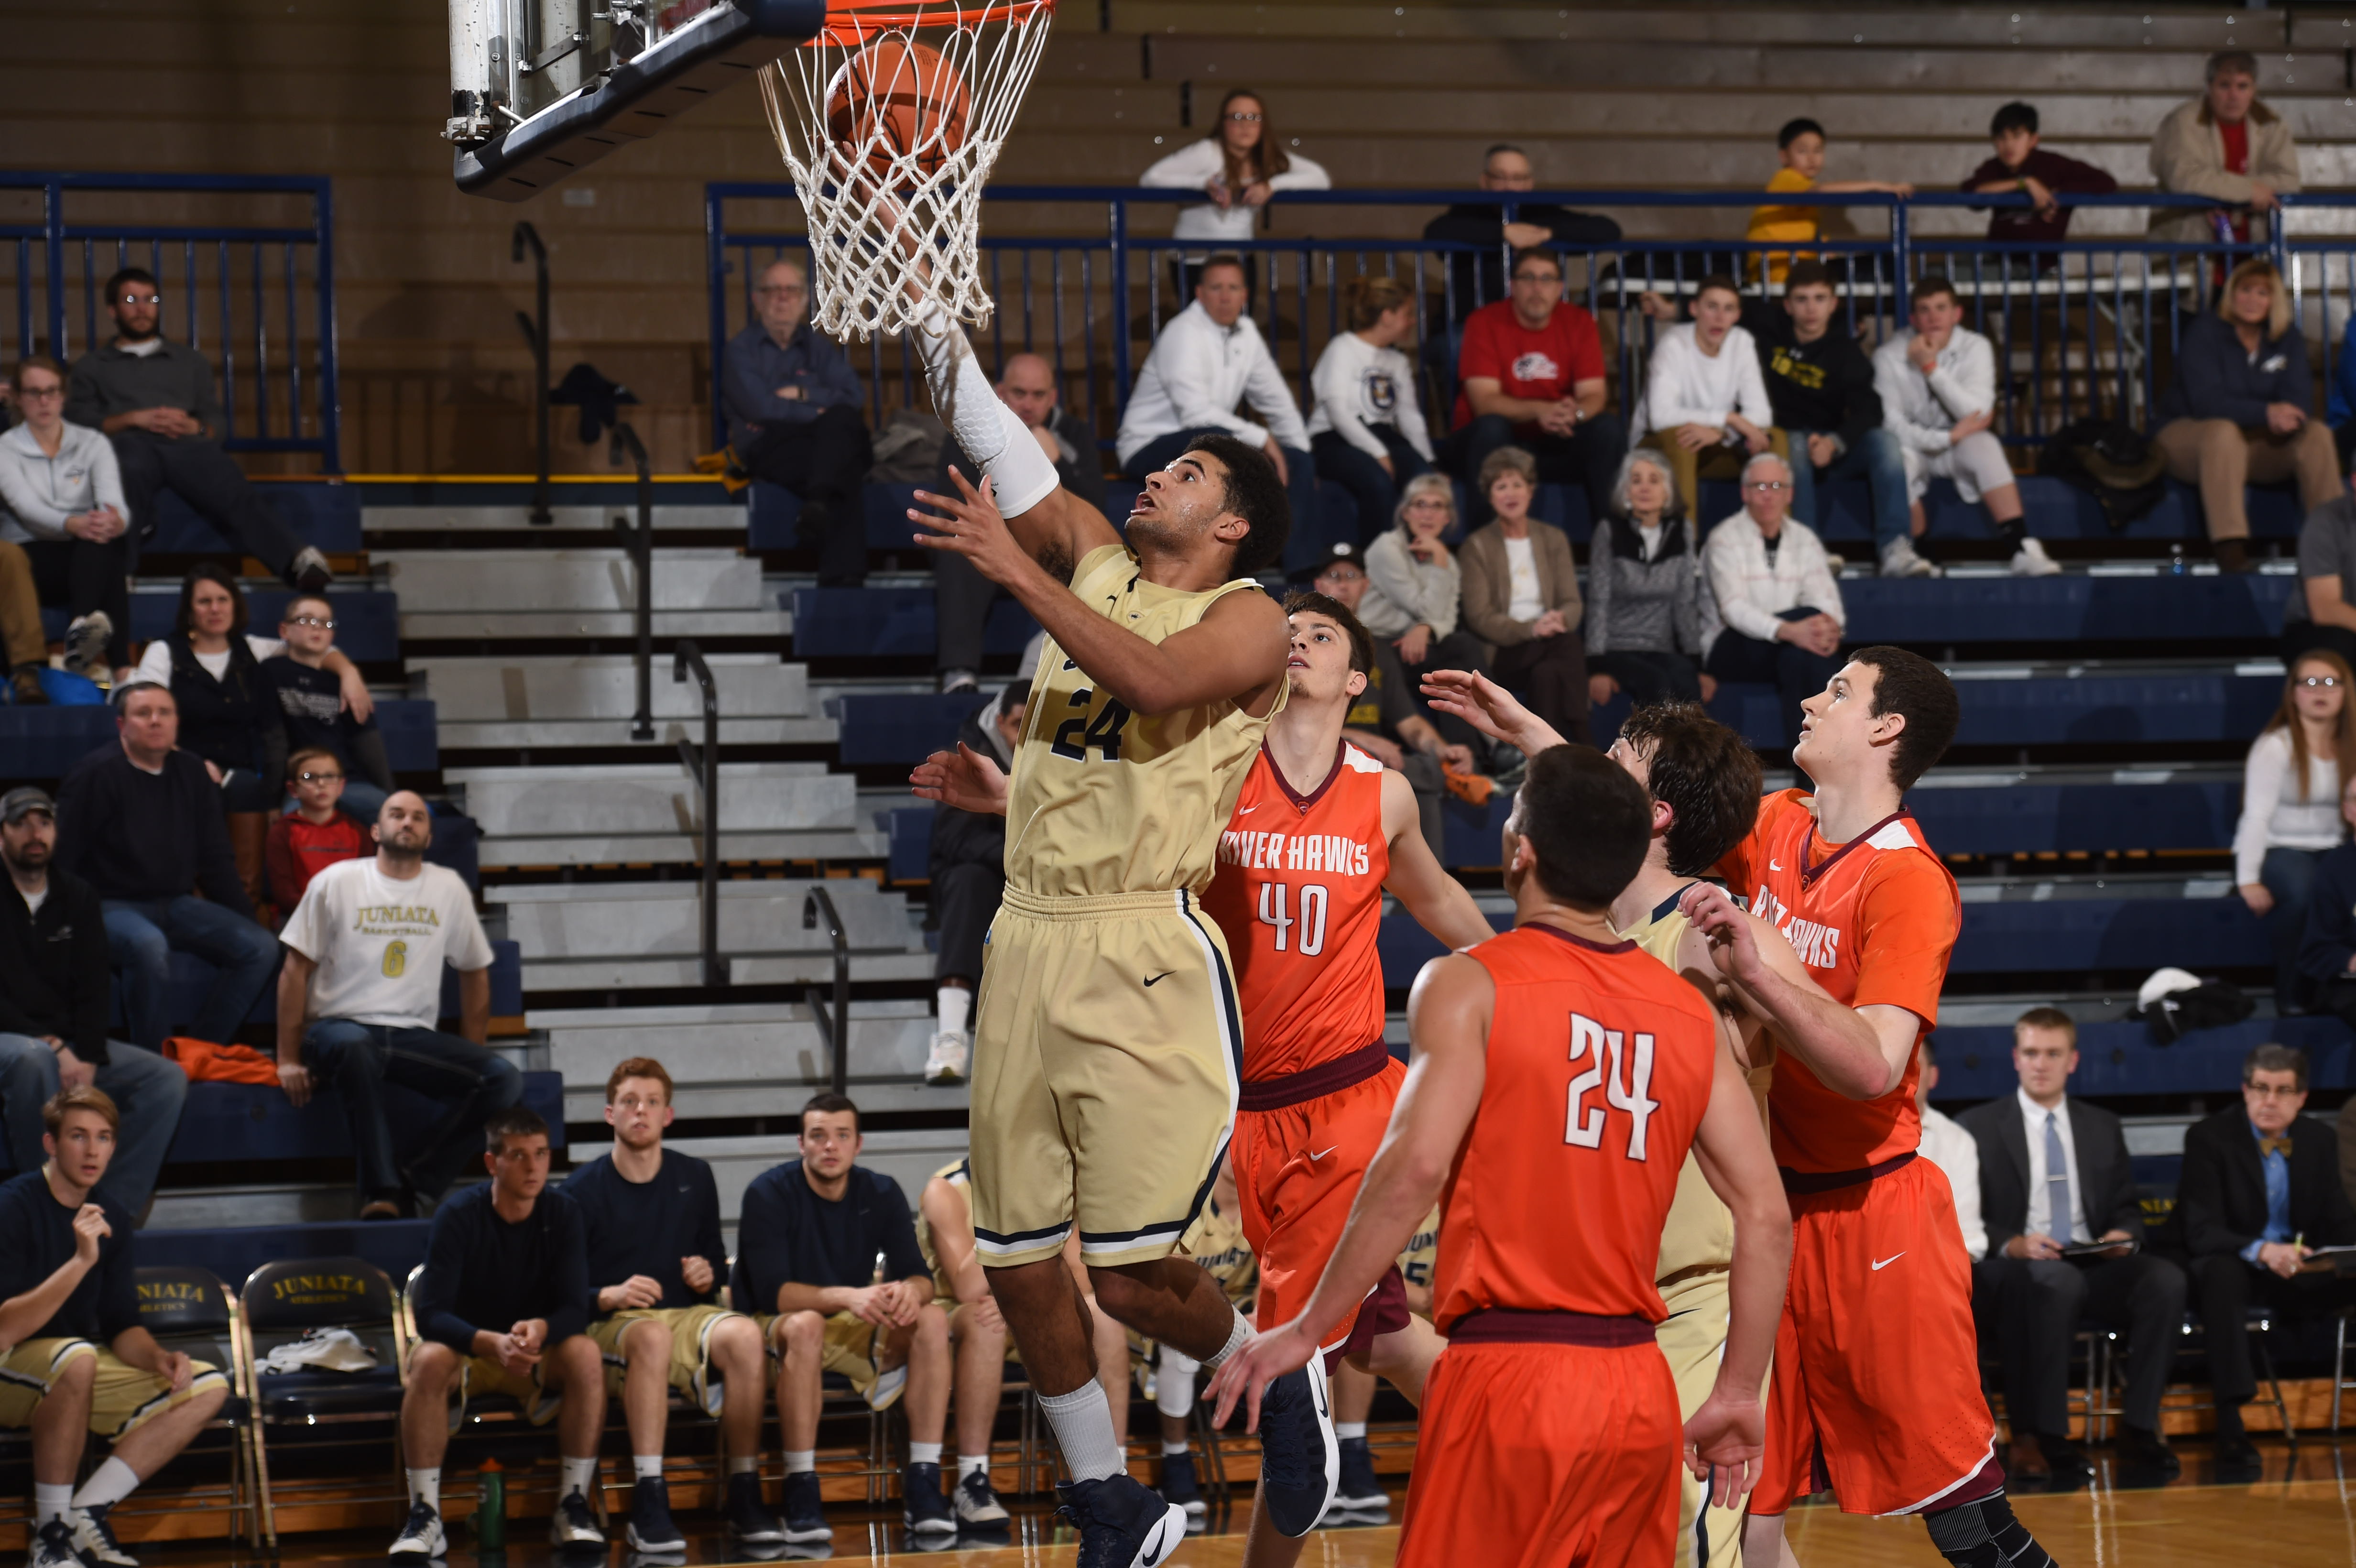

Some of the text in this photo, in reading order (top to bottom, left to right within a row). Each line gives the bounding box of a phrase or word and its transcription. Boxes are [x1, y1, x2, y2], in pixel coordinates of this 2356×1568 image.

[1050, 686, 1132, 762] 24
[1218, 830, 1369, 877] RIVER HAWKS
[353, 905, 440, 931] JUNIATA
[361, 926, 432, 936] BASKETBALL
[1258, 882, 1329, 957] 40
[382, 939, 407, 979] 6
[1563, 1010, 1661, 1164] 24
[273, 1274, 366, 1300] JUNIATA
[1405, 1262, 1428, 1286] 5
[136, 1282, 205, 1303] NIATA
